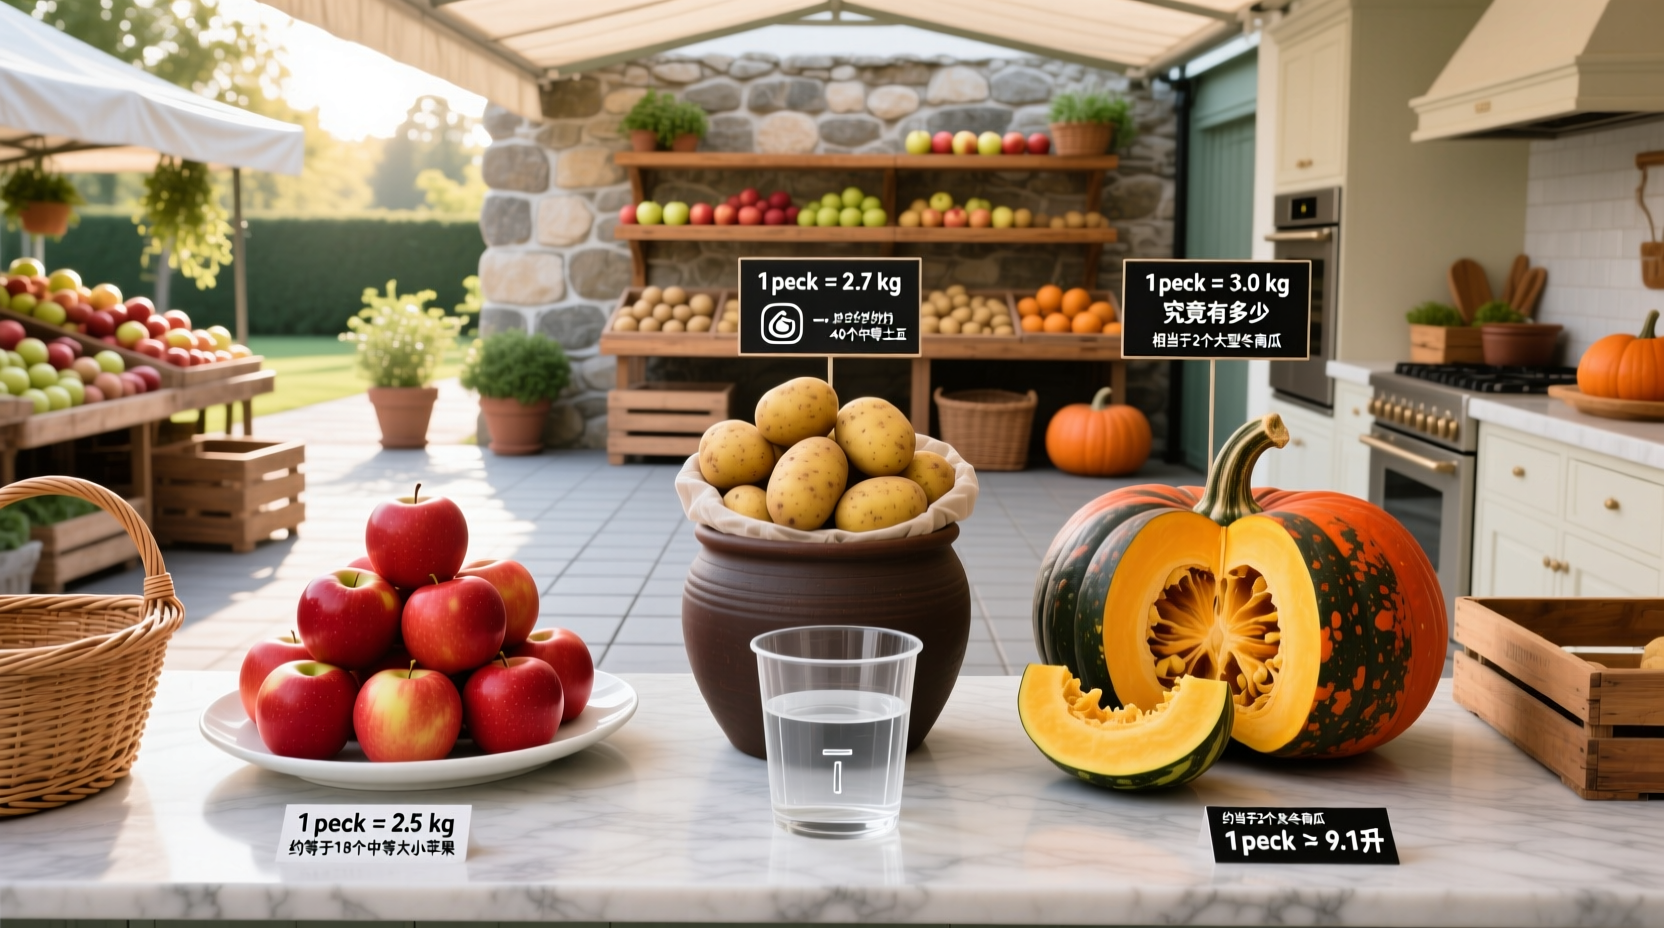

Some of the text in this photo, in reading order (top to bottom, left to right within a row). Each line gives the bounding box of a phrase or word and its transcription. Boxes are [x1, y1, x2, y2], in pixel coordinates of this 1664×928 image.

[772, 272, 818, 296] peck
[825, 277, 837, 287] =
[842, 272, 872, 290] 2.7
[878, 272, 901, 296] kg
[1159, 273, 1206, 297] peck
[1211, 278, 1224, 288] =
[1229, 273, 1260, 292] 3.0
[1266, 273, 1289, 297] kg
[1163, 300, 1270, 324] 究竟有多少
[314, 812, 366, 837] peck
[373, 819, 386, 829] =
[391, 813, 422, 833] 2.5
[429, 813, 454, 838] kg
[289, 840, 455, 856] 约等于18个中等大小苹果
[1242, 829, 1296, 856] peck
[1325, 828, 1384, 853] 9.1升
